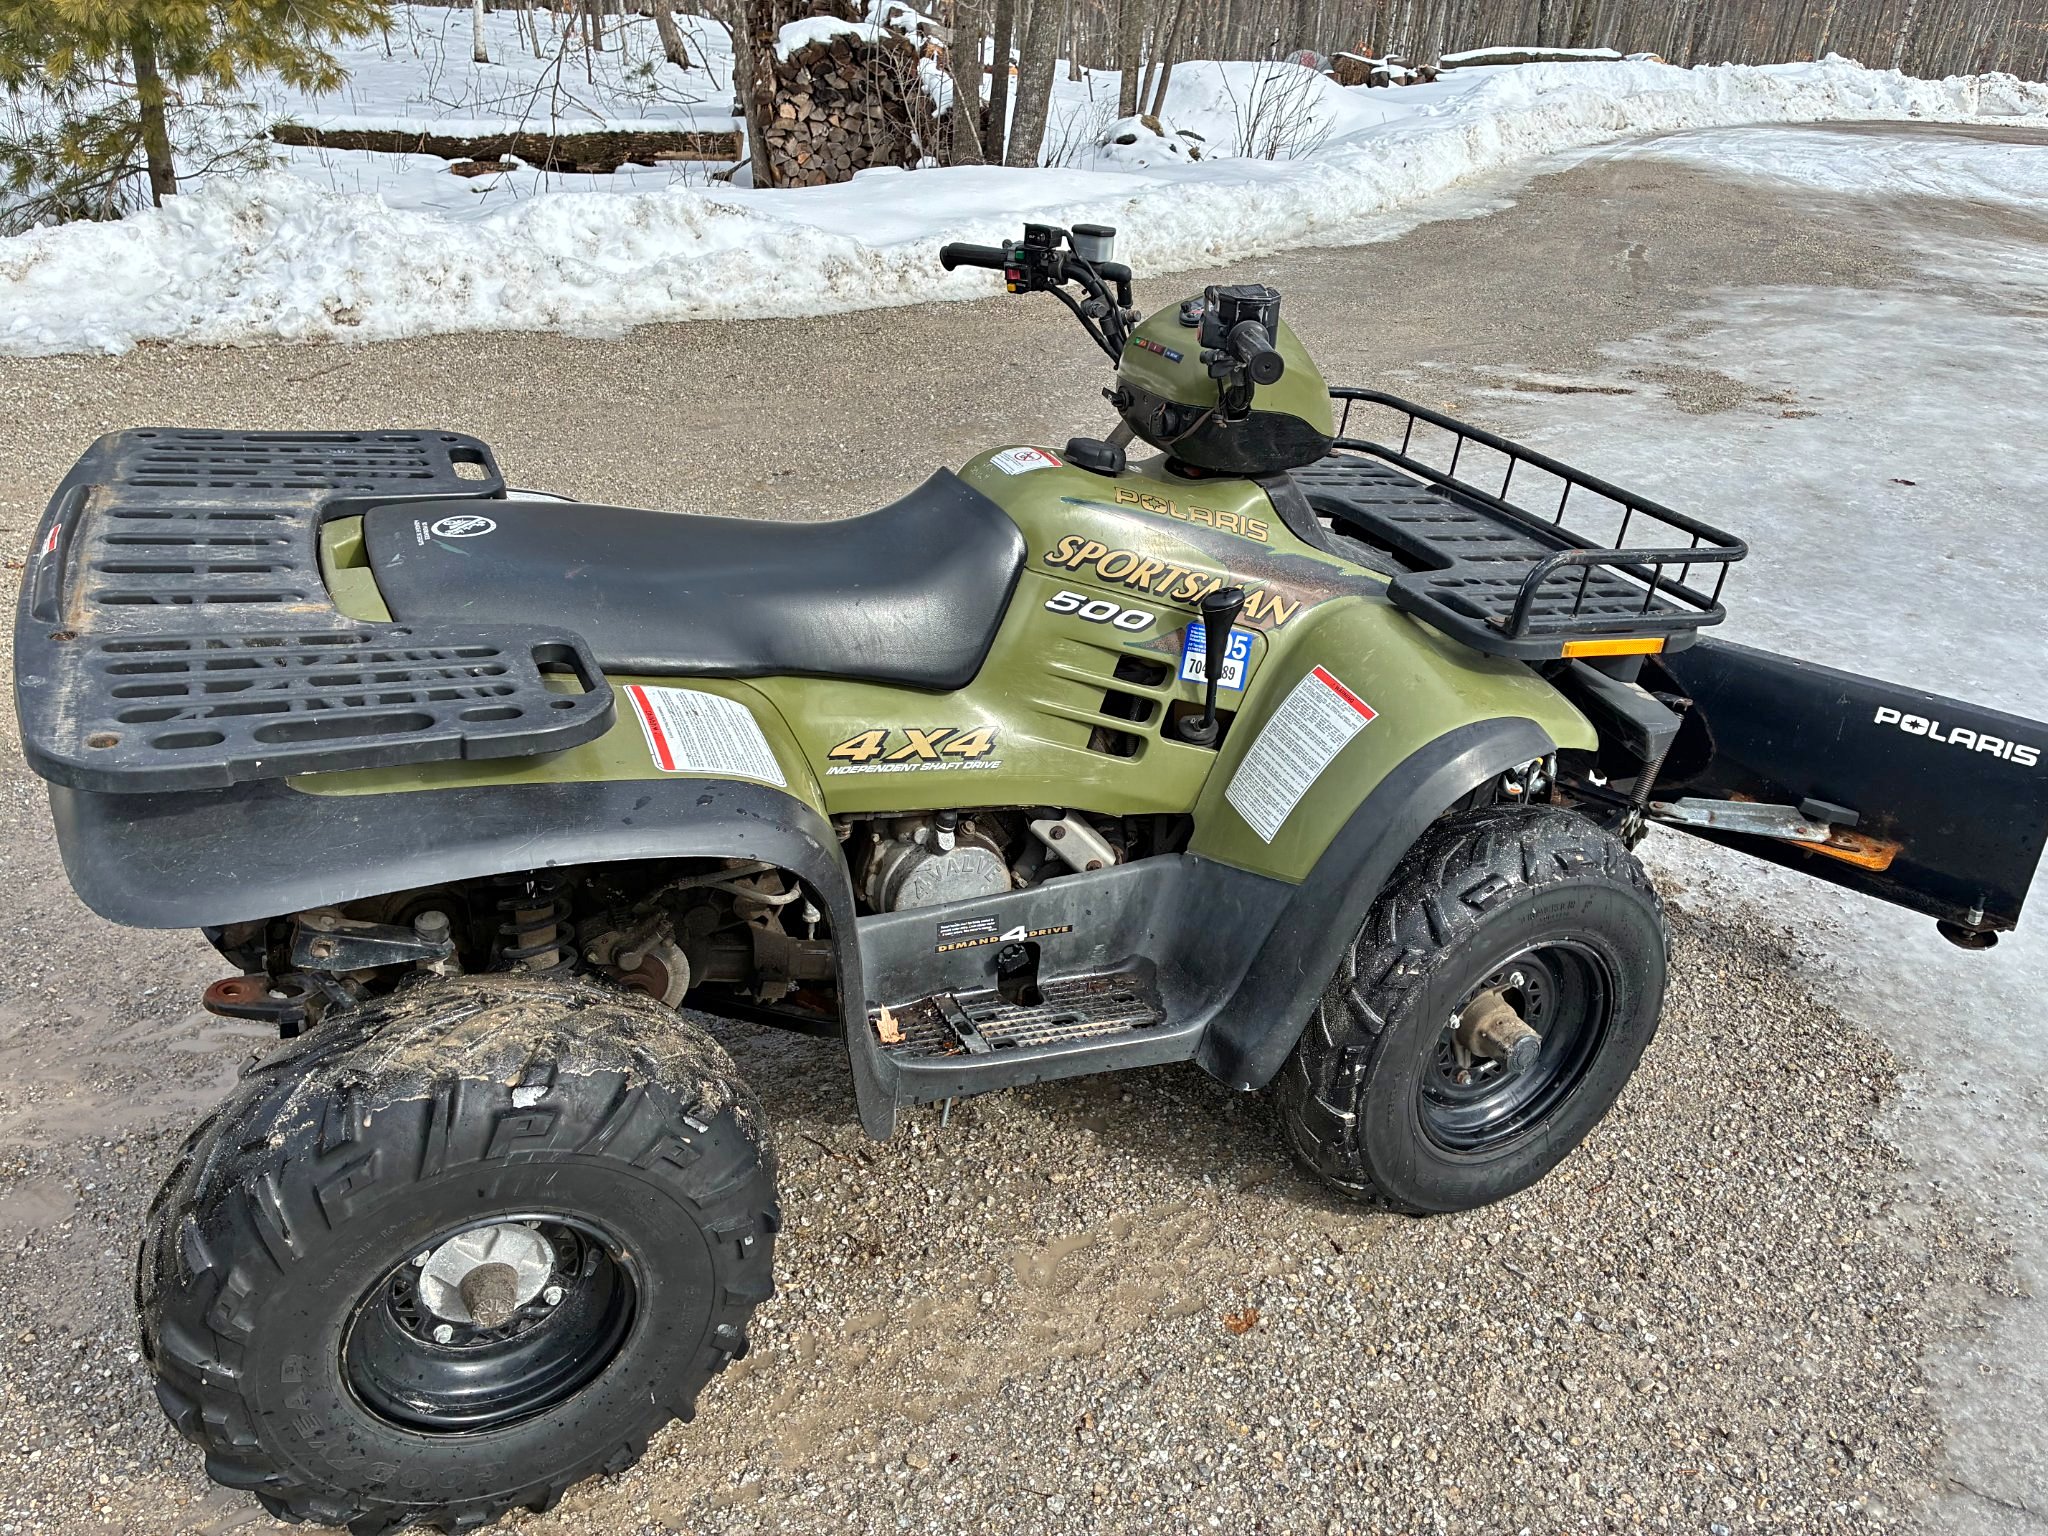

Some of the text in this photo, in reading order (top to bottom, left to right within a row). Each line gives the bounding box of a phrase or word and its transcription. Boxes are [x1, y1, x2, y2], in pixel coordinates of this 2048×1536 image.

[1114, 486, 1269, 542] POLARIS
[1044, 590, 1156, 632] 500
[827, 726, 999, 765] 4X4
[1874, 706, 2041, 767] POLARIS
[826, 761, 1002, 776] INDEPENDENT SHAFT DRIVE
[938, 937, 999, 952] DEMAND
[999, 925, 1028, 942] 4
[1028, 926, 1069, 937] DRIVE
